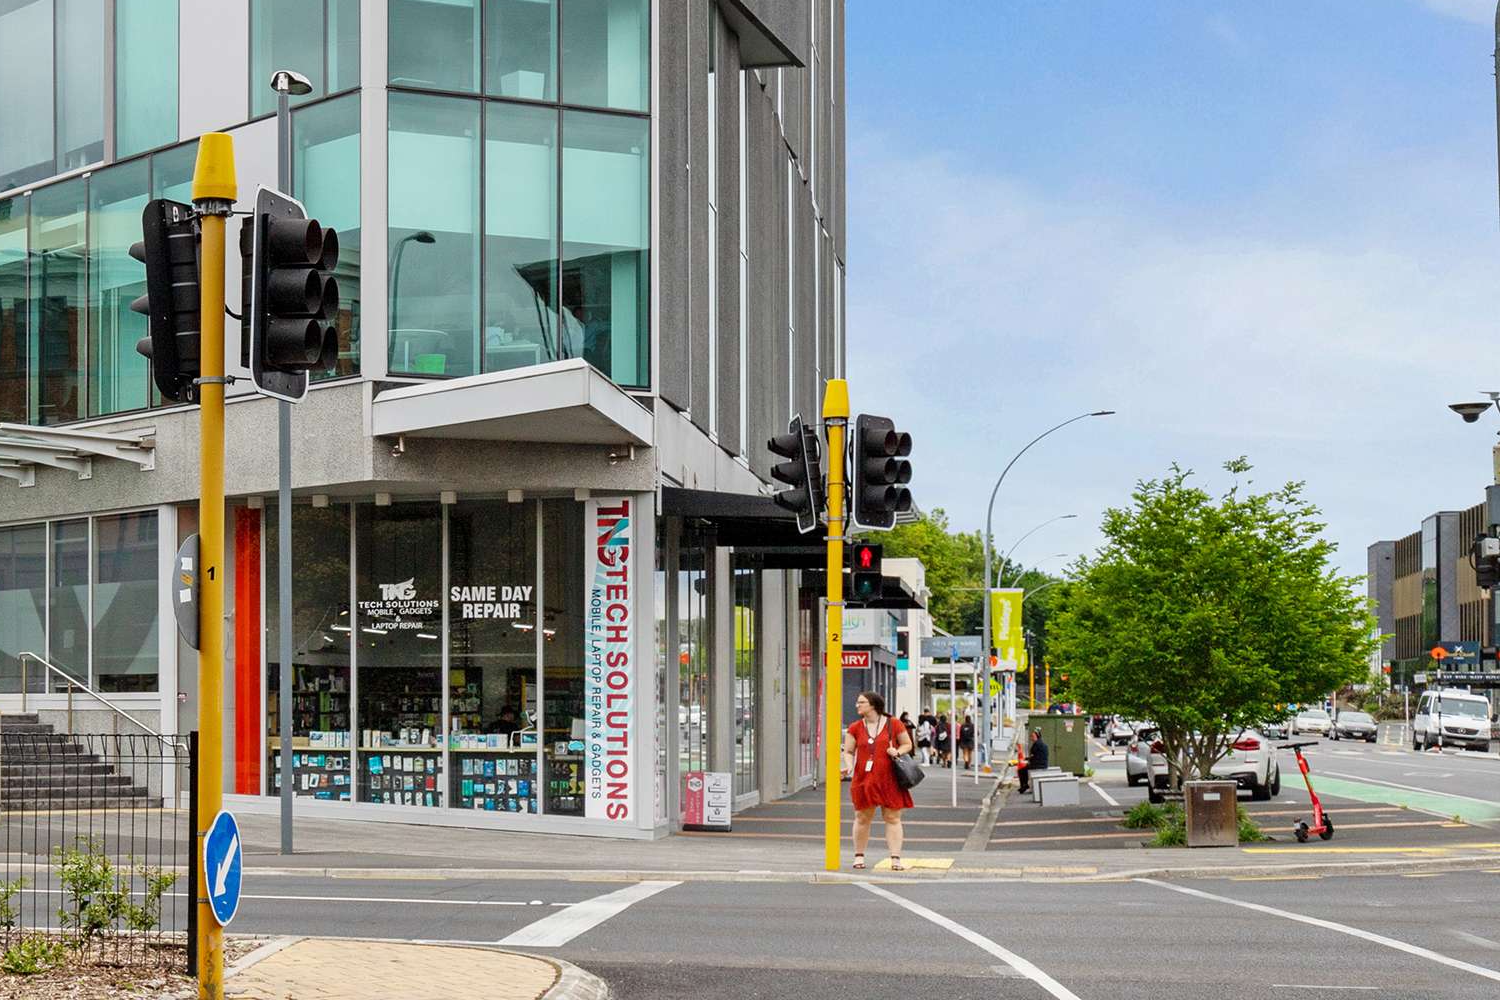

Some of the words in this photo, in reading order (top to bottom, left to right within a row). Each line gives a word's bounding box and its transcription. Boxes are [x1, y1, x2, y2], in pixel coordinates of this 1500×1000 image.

[597, 500, 629, 567] TNG
[207, 566, 215, 581] 1
[358, 601, 383, 609] TECH
[386, 600, 439, 608] SOLUTIONS
[450, 586, 496, 601] SAME
[501, 586, 533, 601] DAY
[606, 566, 628, 643] TECH
[399, 607, 433, 615] GADGETS
[462, 603, 521, 619] REPAIR
[591, 589, 601, 635] MOBILE,
[371, 622, 399, 630] LAPTOP
[399, 622, 423, 630] REPAIR
[832, 633, 839, 642] 2
[591, 640, 602, 684] LAPTOP
[591, 687, 602, 729] REPAIR
[606, 651, 628, 820] SOLUTIONS
[591, 743, 602, 799] GADGETS
